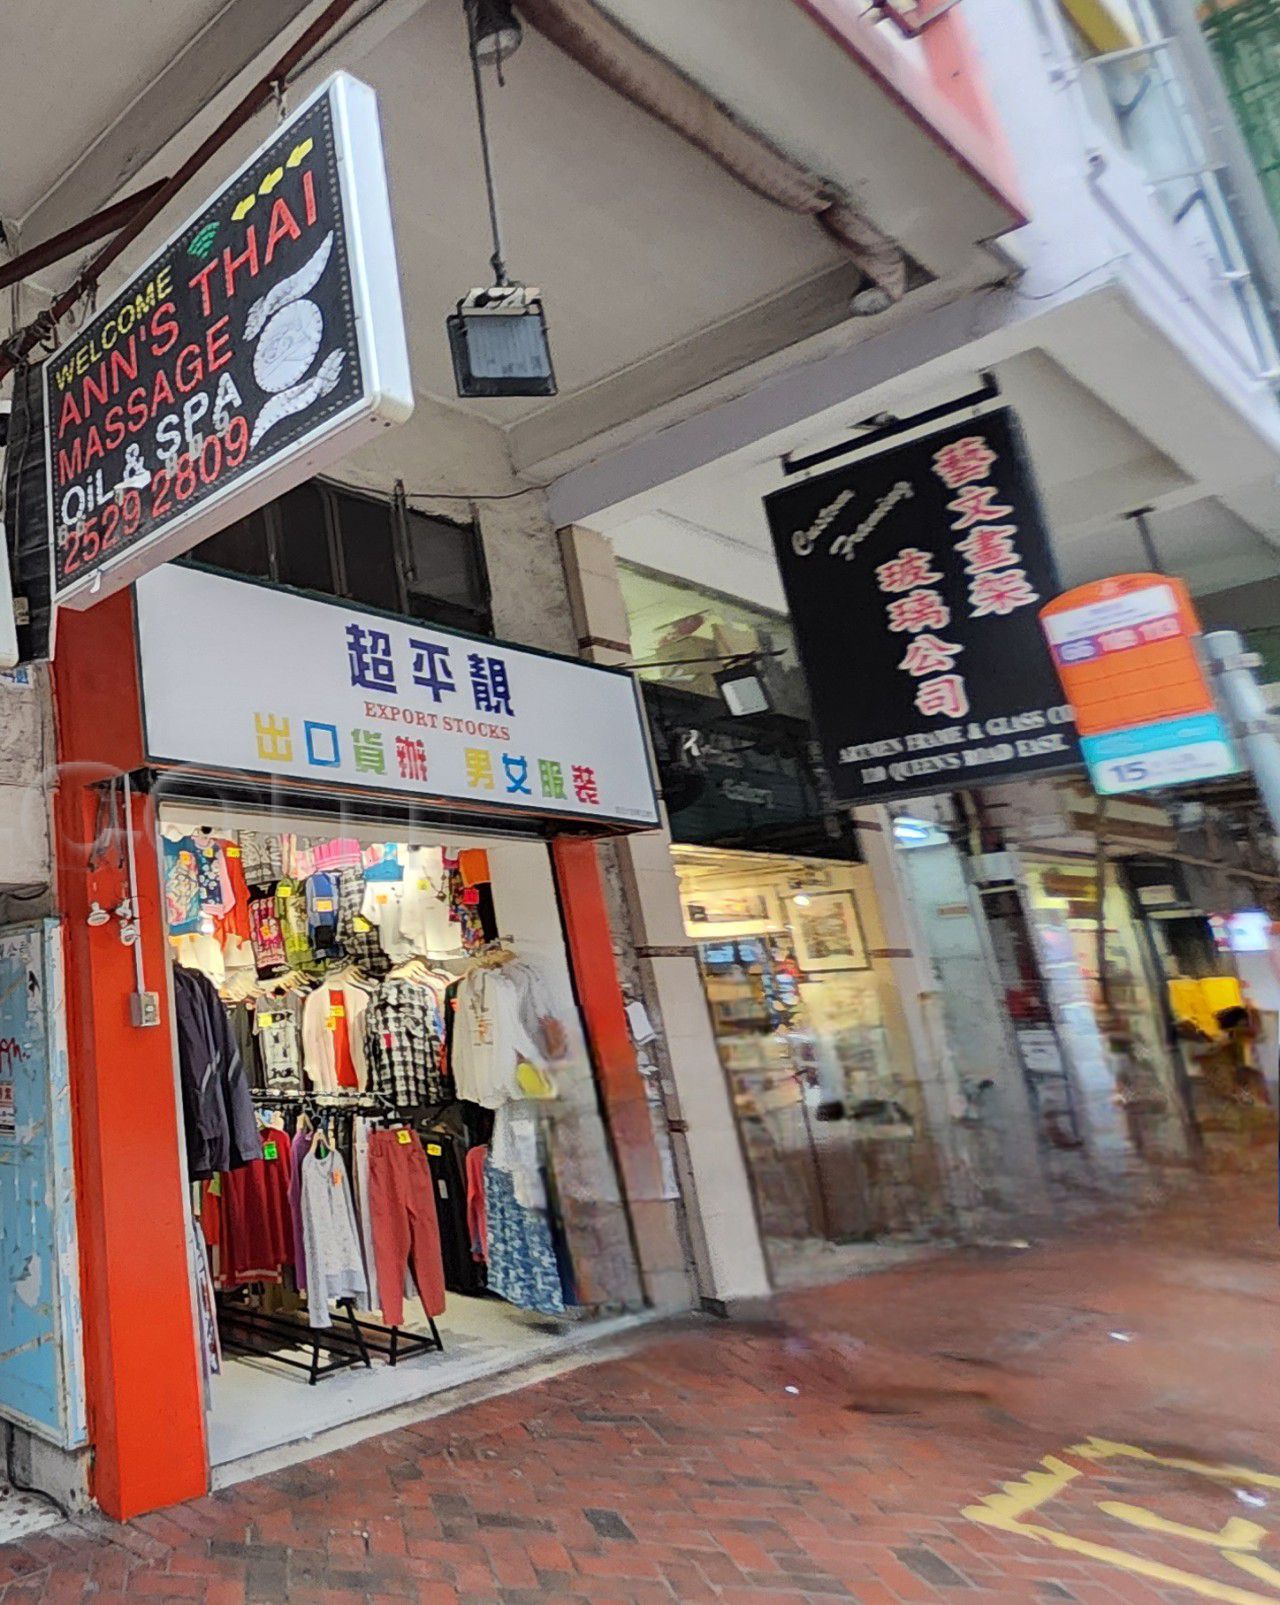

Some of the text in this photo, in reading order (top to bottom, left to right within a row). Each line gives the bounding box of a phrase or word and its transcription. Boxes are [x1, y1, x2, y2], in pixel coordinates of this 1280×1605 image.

[55, 265, 174, 391] WELCOME
[58, 170, 318, 439] ANN'S THAI
[58, 315, 233, 486] MASSAGE
[123, 443, 146, 481] &
[155, 372, 243, 460] SPA
[64, 416, 248, 574] 2529 2809
[345, 623, 516, 718] 超平靚
[875, 548, 970, 718] 玻璃公司
[364, 700, 511, 741] EXPORT STOCKS
[464, 747, 599, 806] 男女服裝
